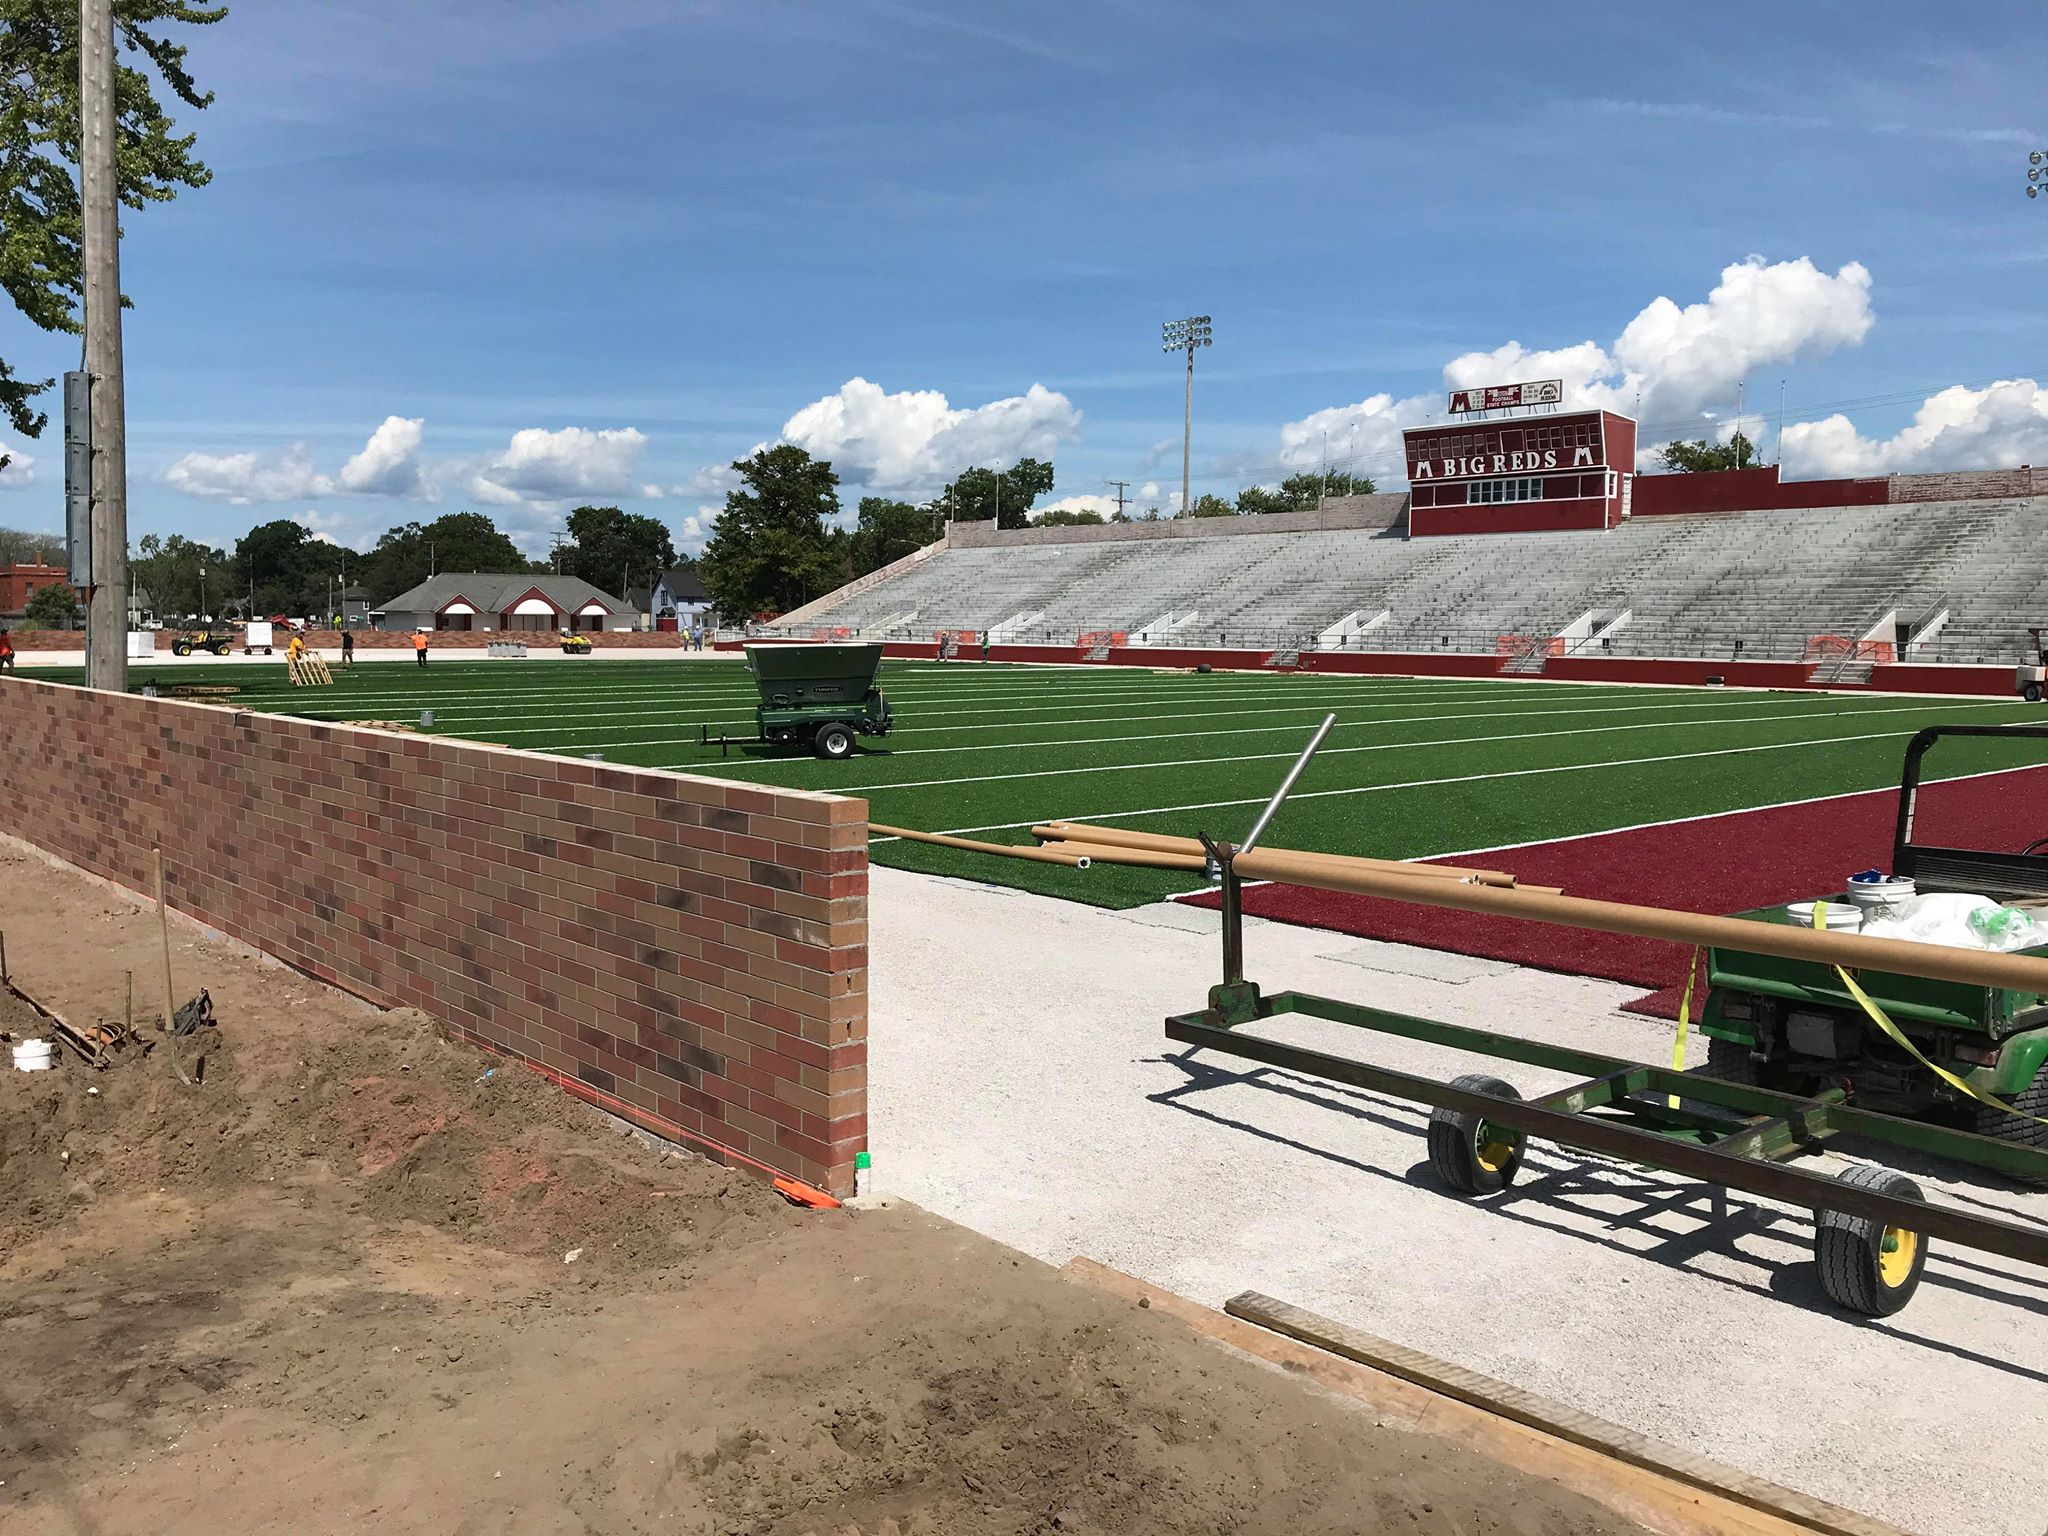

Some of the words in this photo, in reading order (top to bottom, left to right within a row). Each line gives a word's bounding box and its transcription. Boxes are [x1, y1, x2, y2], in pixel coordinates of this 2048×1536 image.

[1450, 392, 1472, 412] M
[1415, 461, 1434, 478] M
[1443, 456, 1486, 477] BIG
[1493, 450, 1557, 473] REDS
[1573, 447, 1594, 467] M
